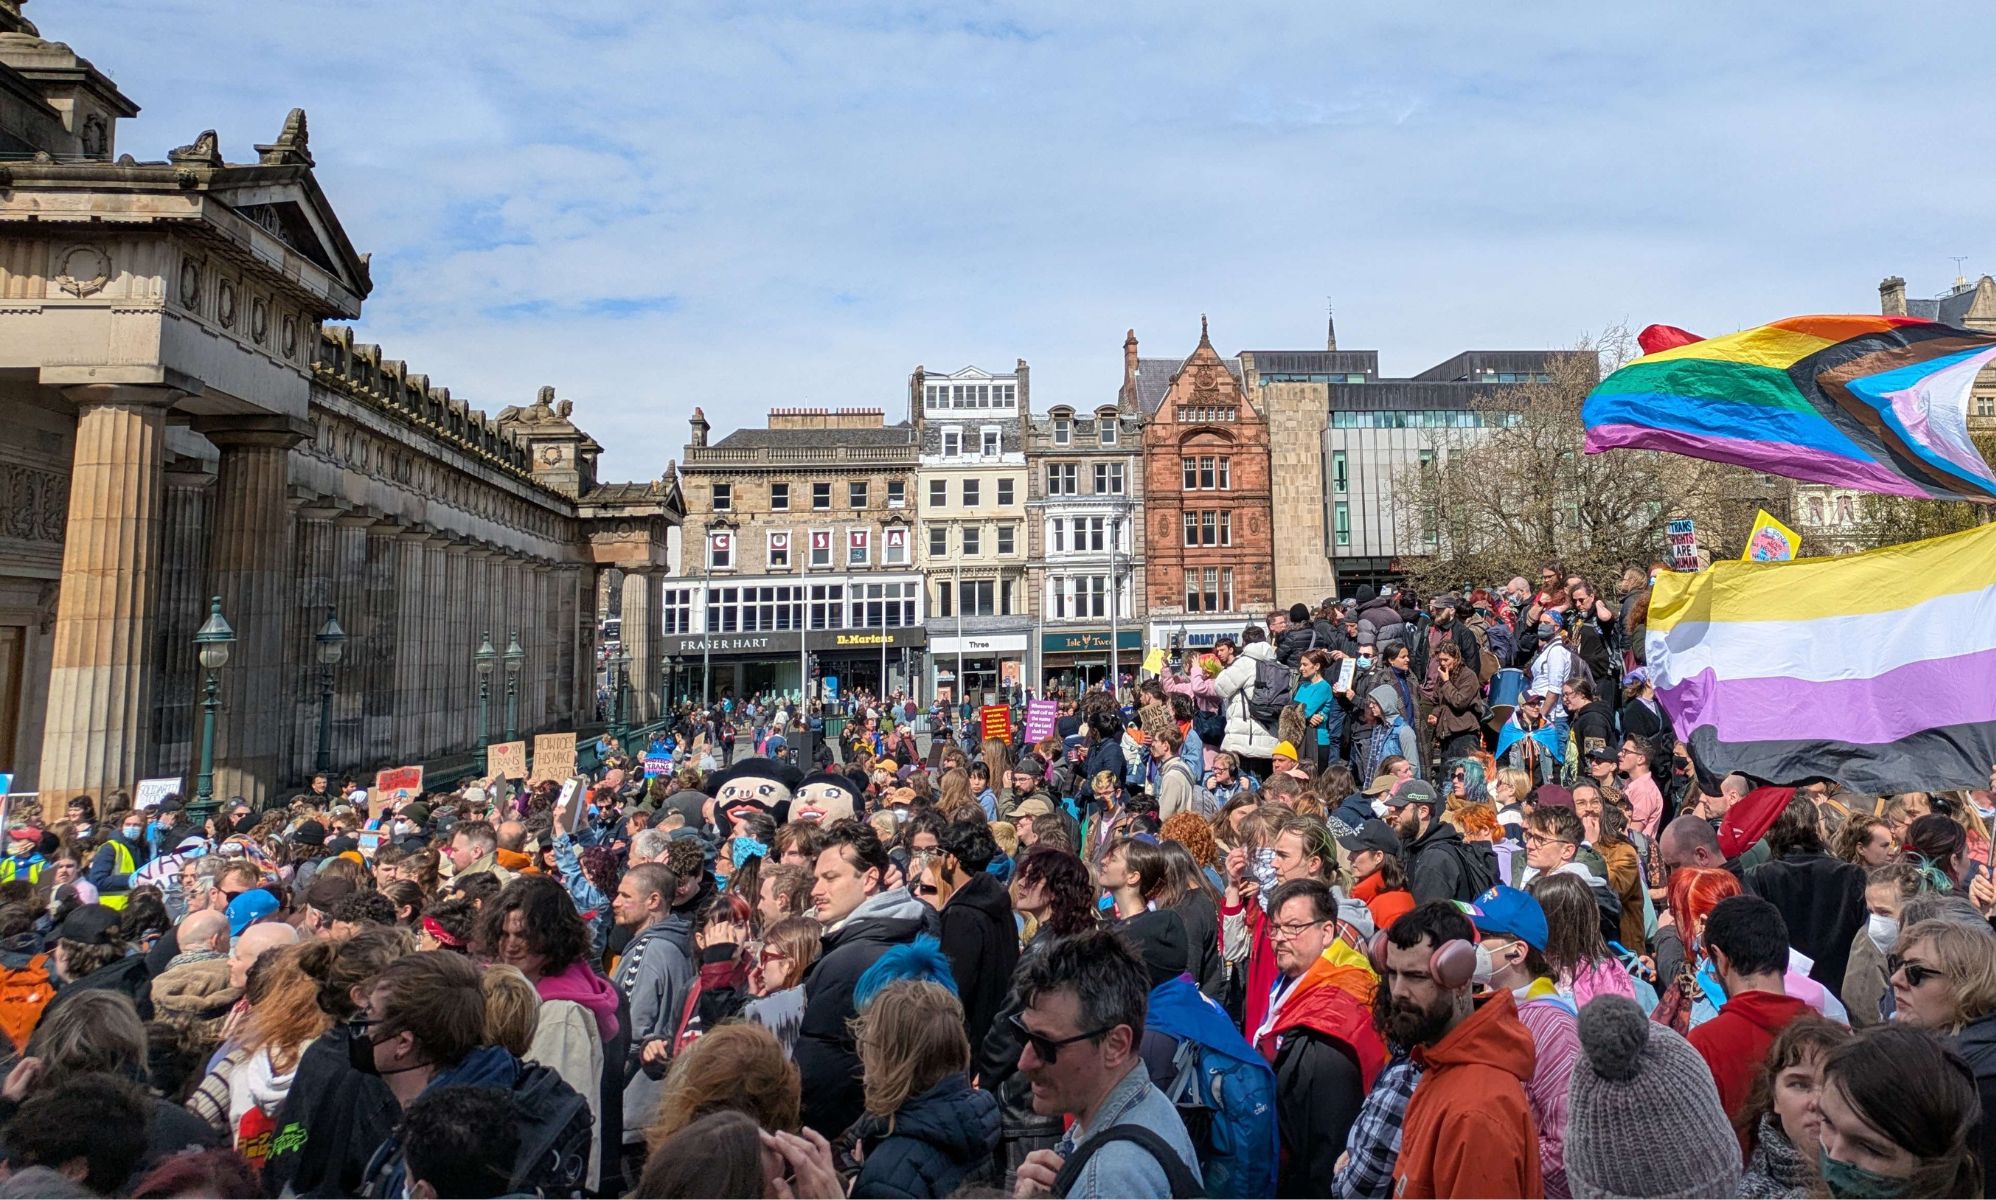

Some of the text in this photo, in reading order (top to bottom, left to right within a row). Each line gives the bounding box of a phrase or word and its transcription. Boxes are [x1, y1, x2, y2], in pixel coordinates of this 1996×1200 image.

[1670, 520, 1692, 533] TRANS
[1671, 533, 1694, 545] RIGHTS
[1676, 545, 1692, 556] ARE
[1675, 556, 1699, 568] HUMAN
[680, 638, 768, 650] FRASER HART
[1066, 638, 1081, 647] Isle
[1189, 634, 1215, 645] GREAT
[509, 743, 523, 756] MY
[535, 736, 574, 752] HOW DOES
[490, 755, 520, 768] TRANS
[535, 750, 571, 766] THIS MAKE
